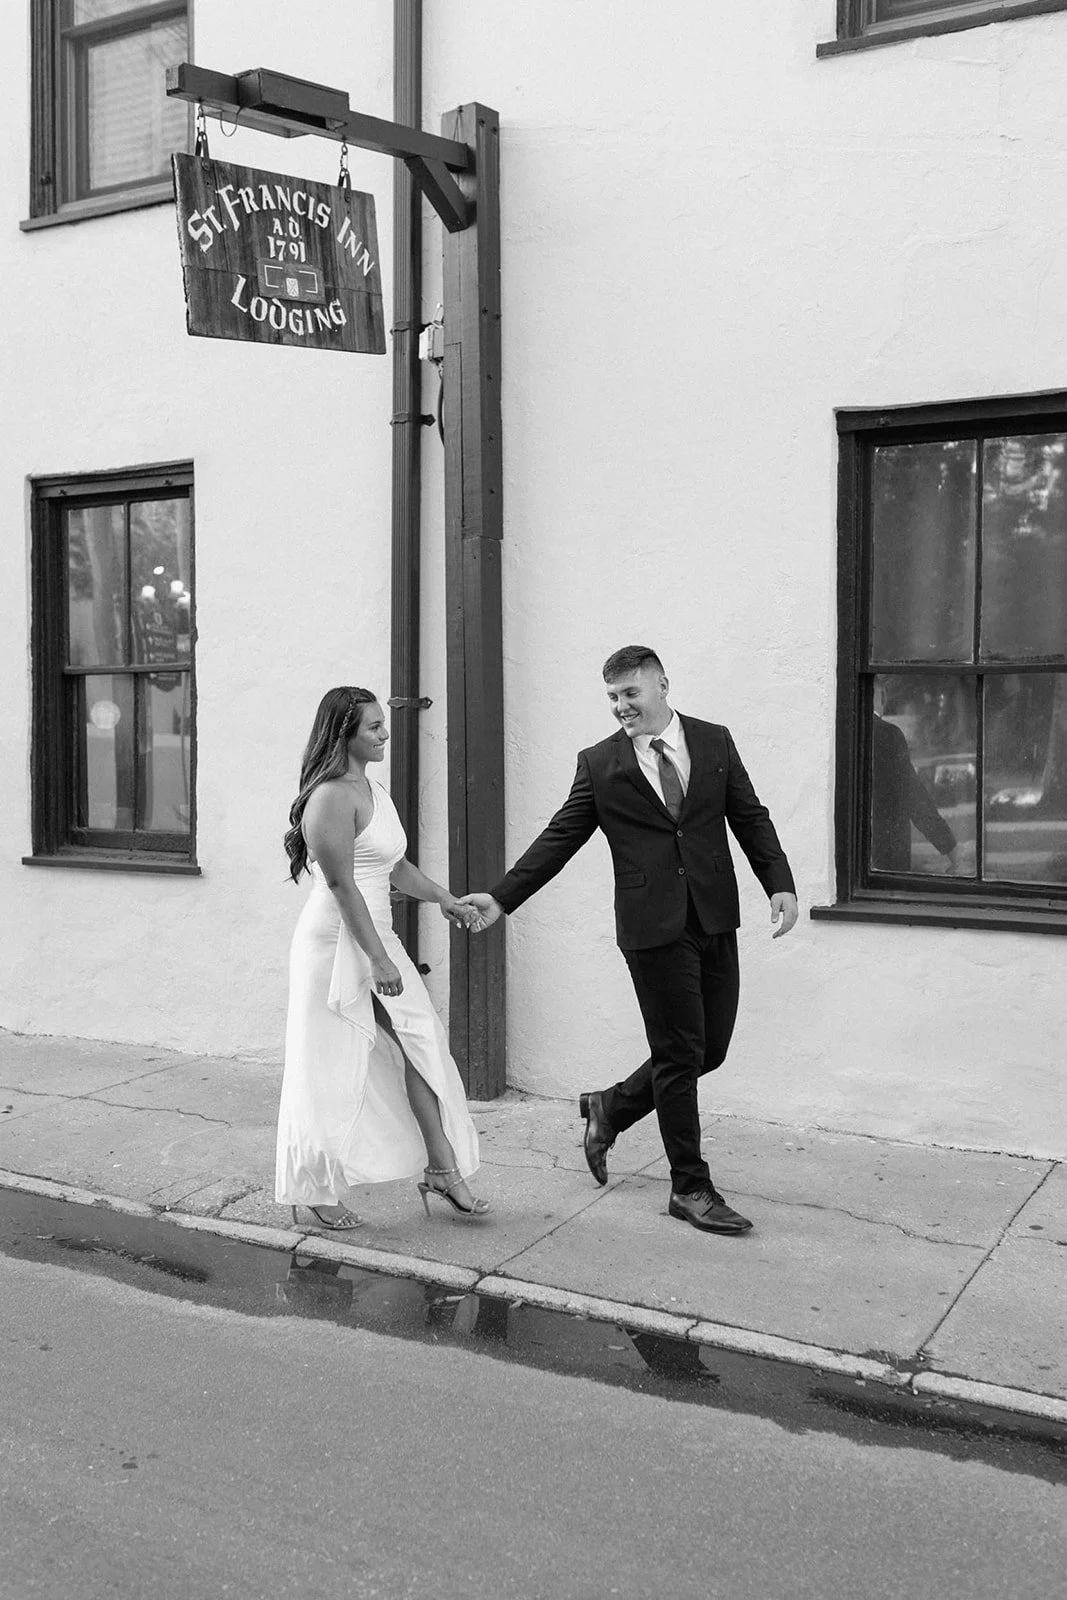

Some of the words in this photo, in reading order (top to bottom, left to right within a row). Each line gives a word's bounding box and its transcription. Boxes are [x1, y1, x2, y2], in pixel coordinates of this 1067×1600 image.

[187, 209, 227, 255] ST.
[215, 184, 332, 232] FRANCIS
[336, 216, 375, 277] INN
[268, 236, 306, 263] 1791
[273, 216, 302, 239] A.D.
[230, 274, 348, 336] LODGING
